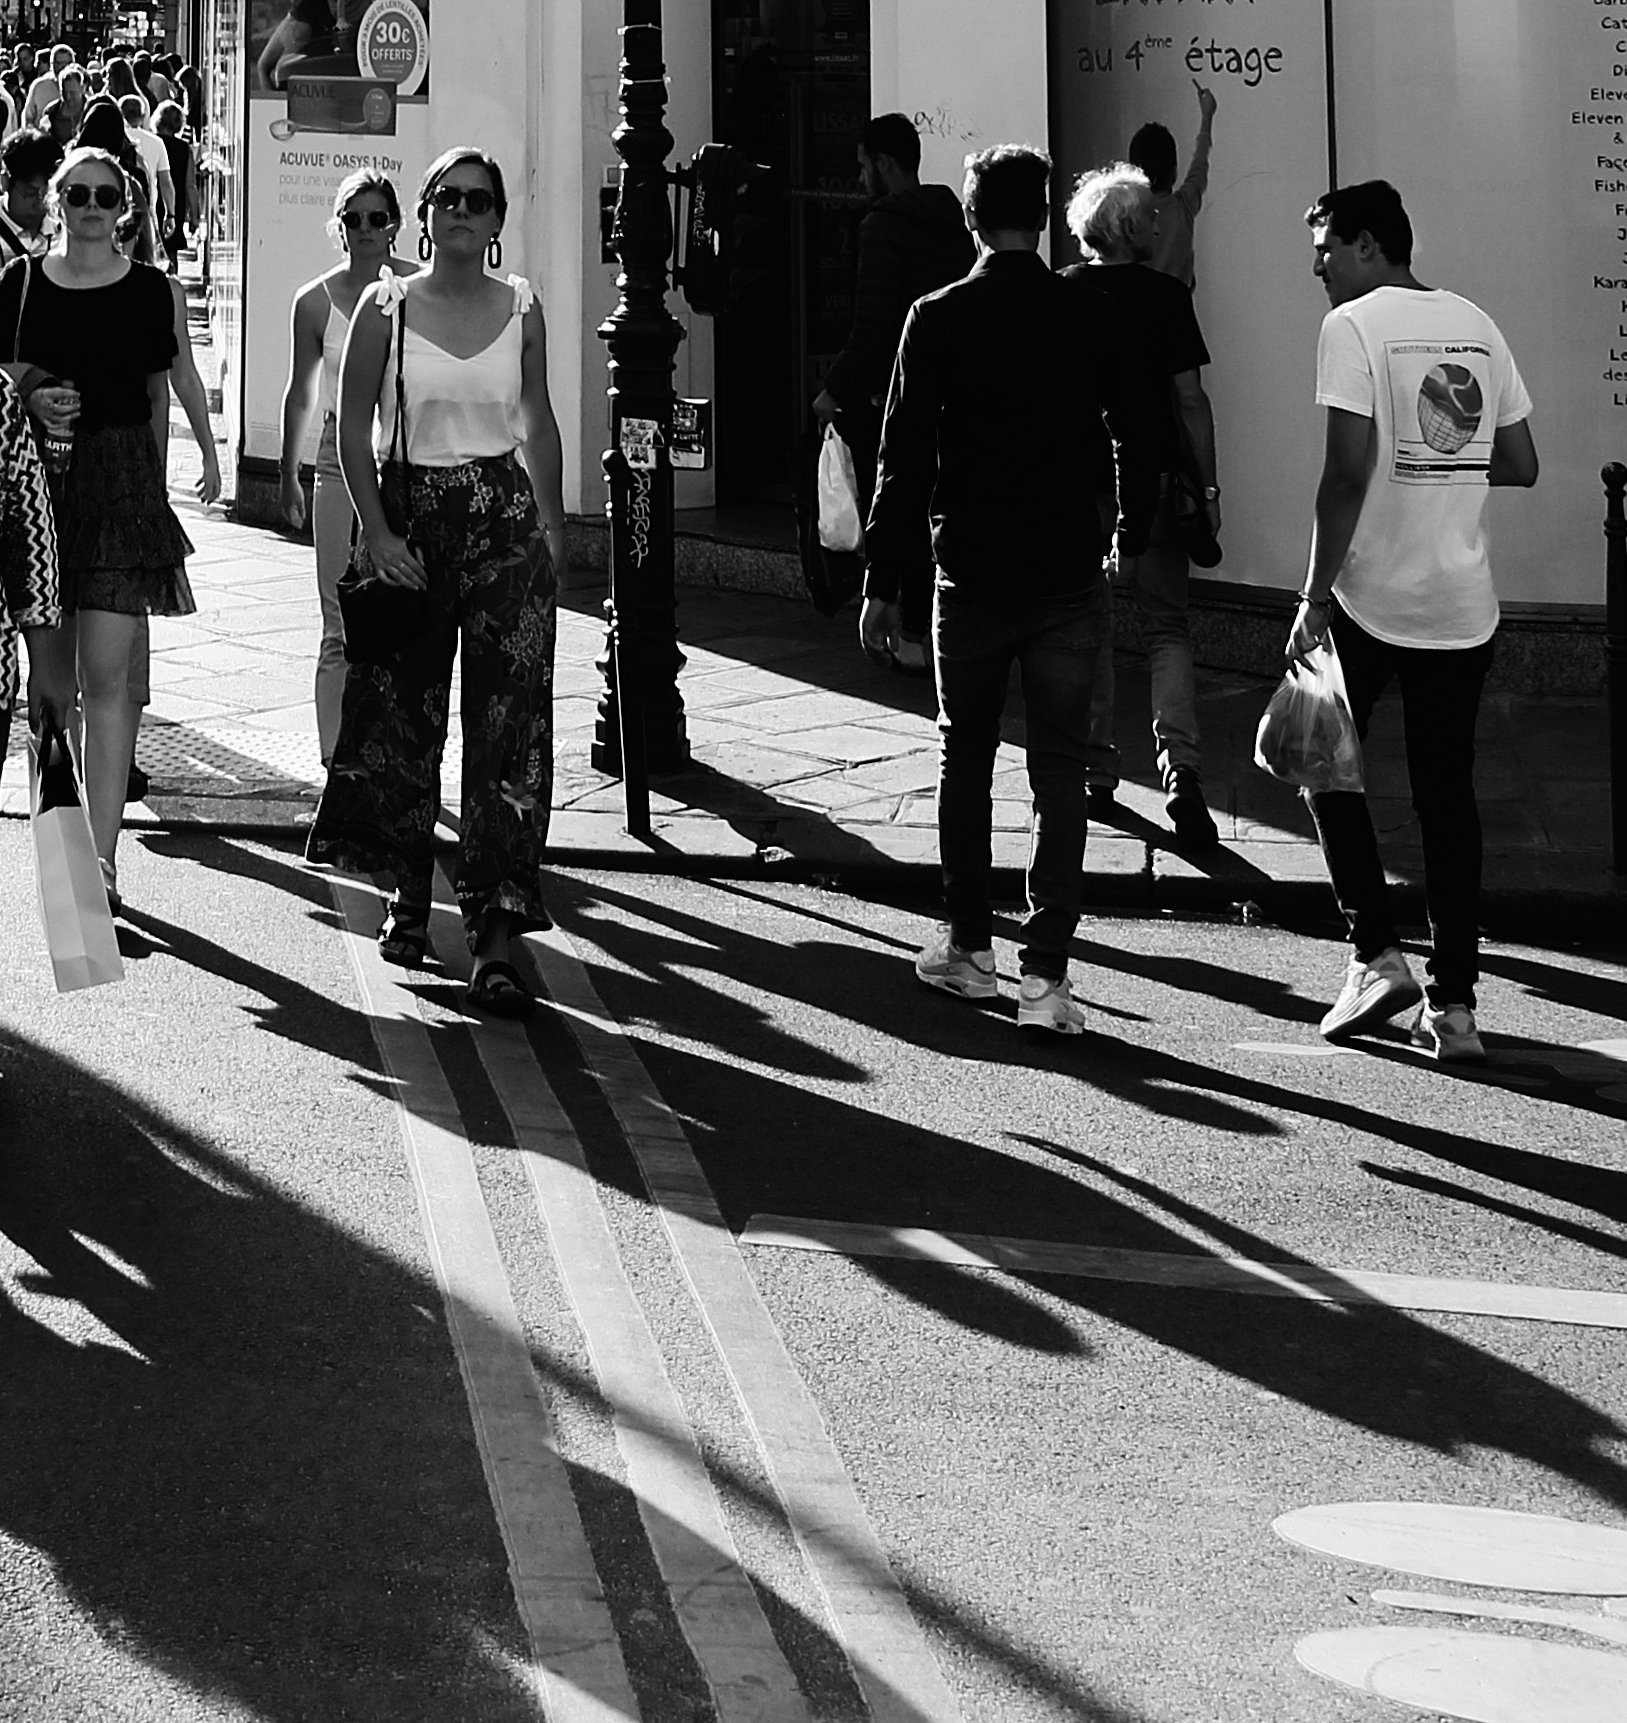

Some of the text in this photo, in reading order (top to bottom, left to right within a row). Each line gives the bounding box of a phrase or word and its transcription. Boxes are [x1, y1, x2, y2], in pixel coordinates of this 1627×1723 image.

[1077, 44, 1113, 73] au
[1184, 35, 1283, 88] étage
[1571, 111, 1624, 125] Eleven
[333, 154, 369, 169] OASYS
[279, 175, 300, 187] pour
